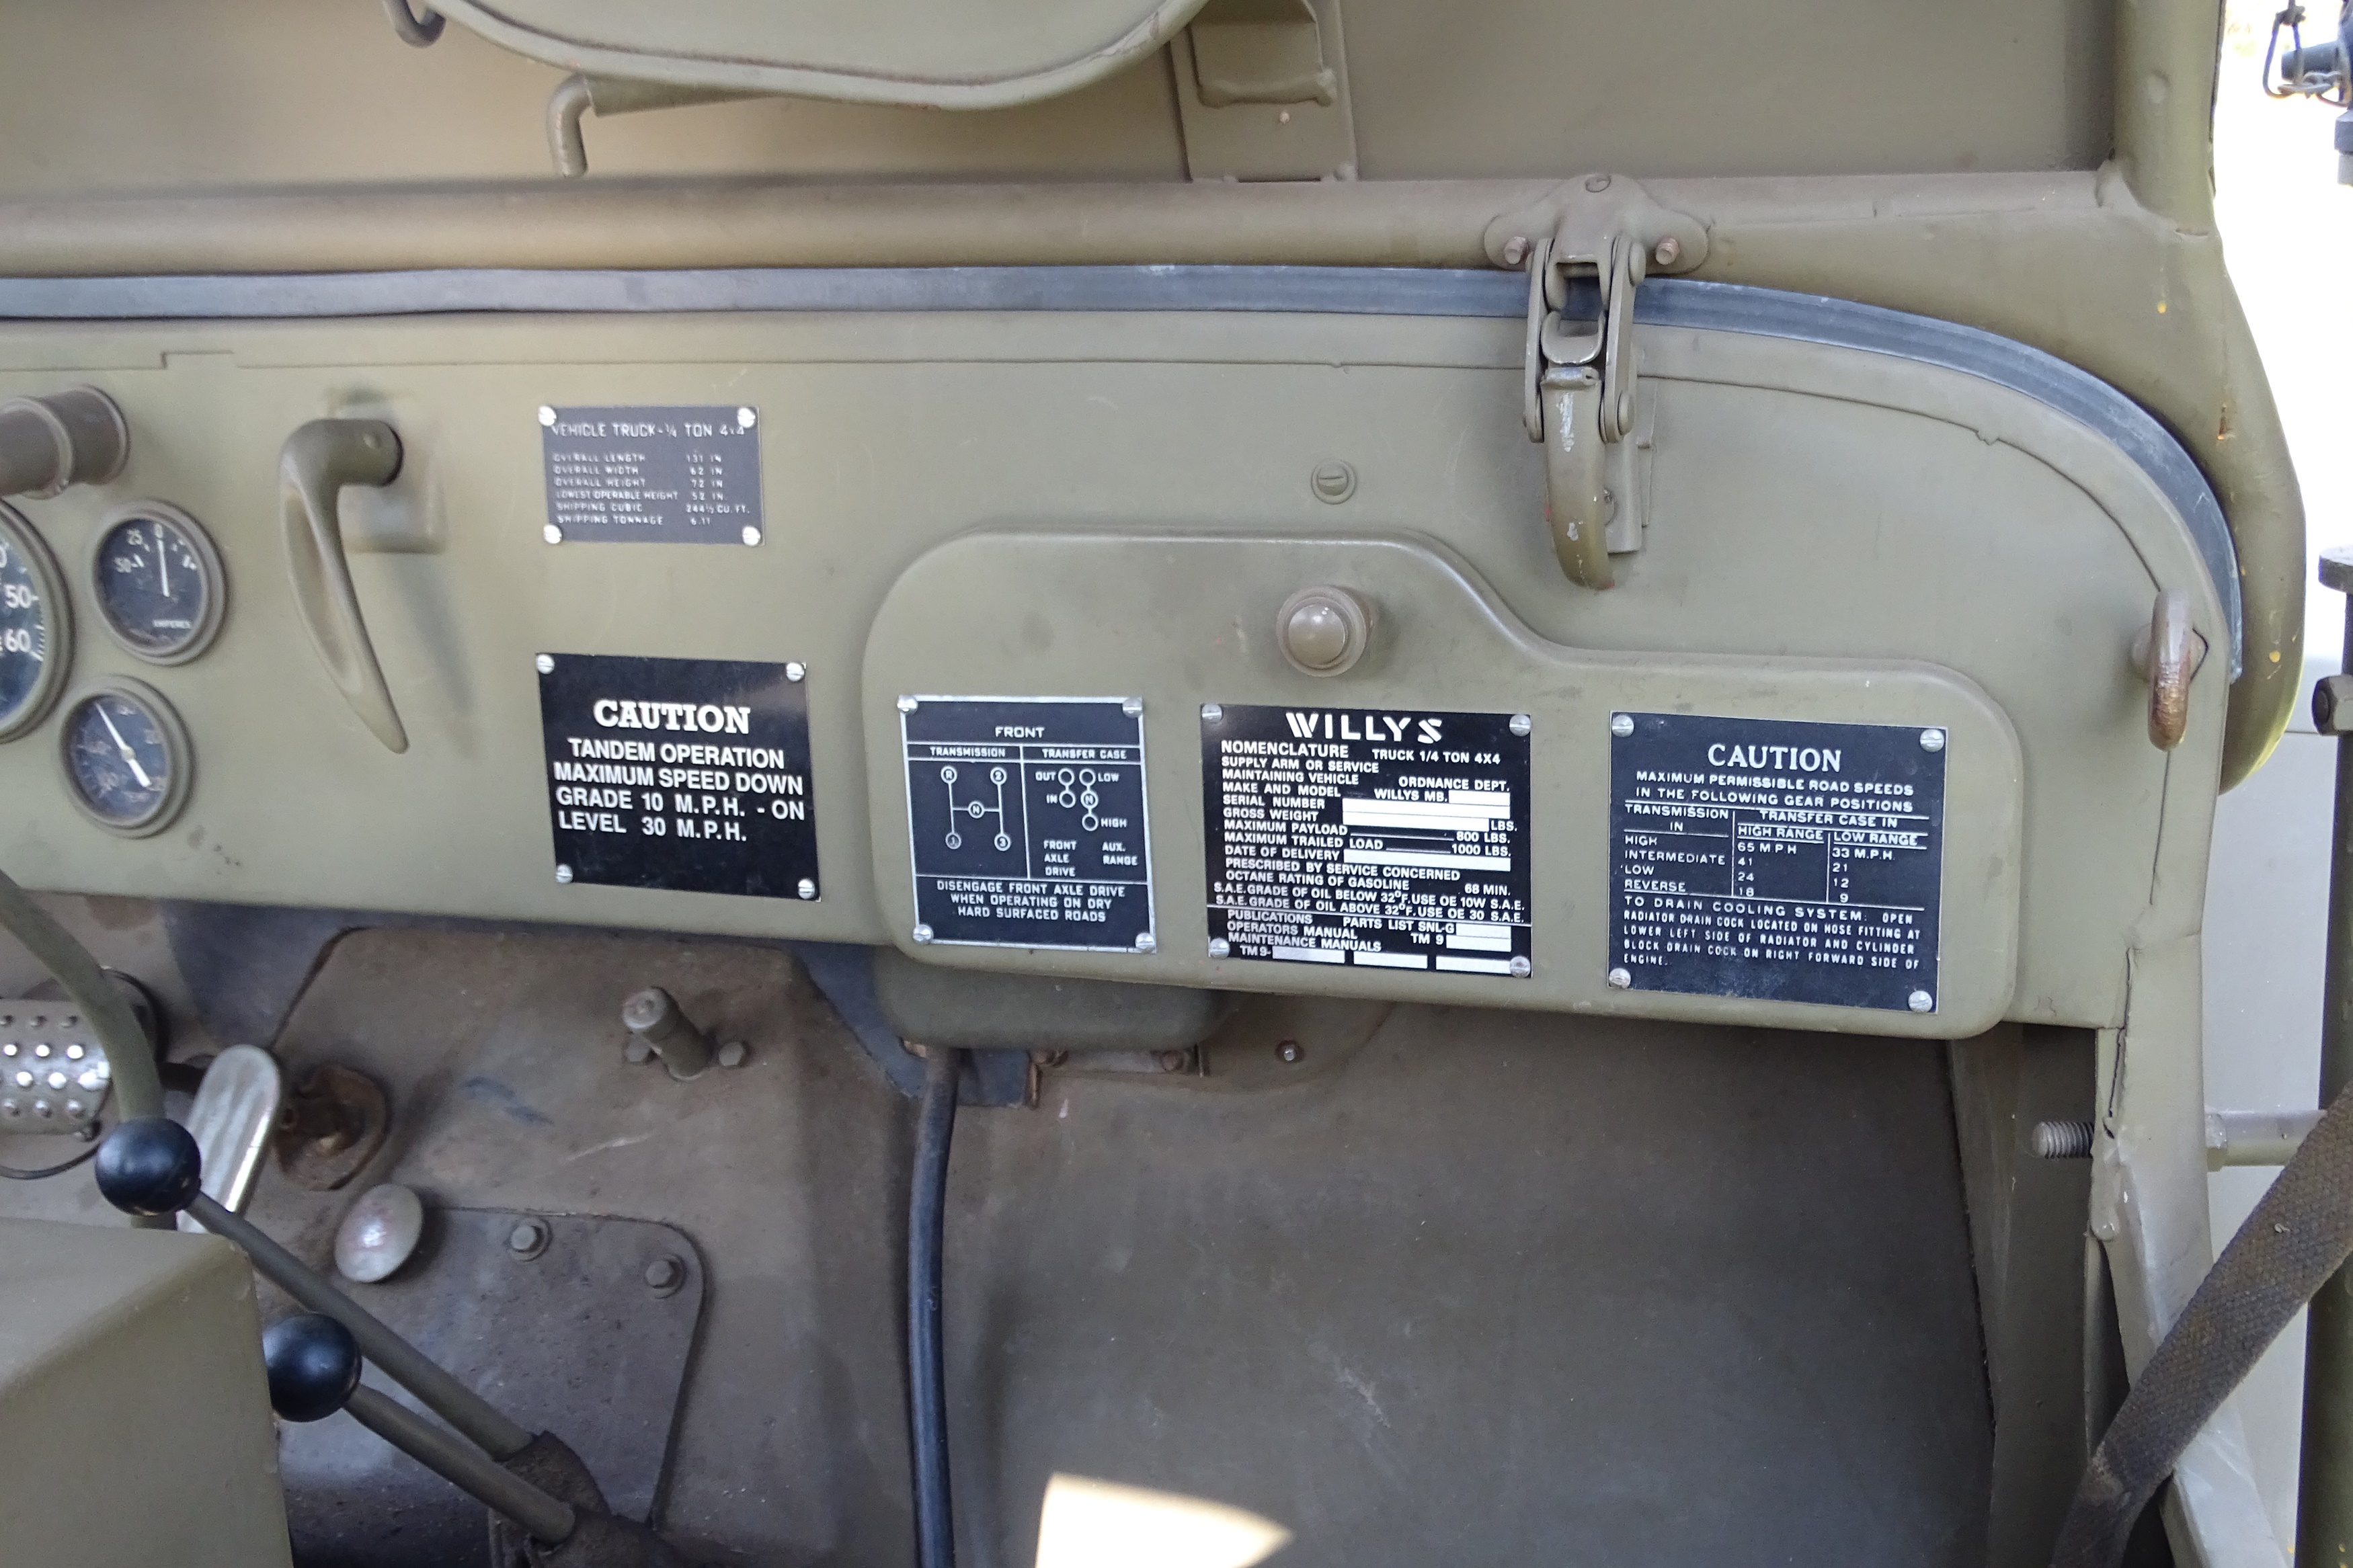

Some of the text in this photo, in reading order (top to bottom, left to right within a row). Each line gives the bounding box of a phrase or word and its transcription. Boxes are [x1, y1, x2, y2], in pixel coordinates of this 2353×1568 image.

[5, 585, 32, 608] 50
[5, 628, 31, 653] 60
[594, 698, 750, 735] CAUTION
[995, 727, 1045, 739] FRONT
[1285, 712, 1442, 743] WILLYS
[567, 738, 785, 769] TANDEM OPERATION
[930, 747, 1006, 757] TRANSMISSION
[1042, 749, 1127, 759] TRANSFER CASE
[1222, 741, 1501, 764] NOMENCLATURE TRUCK 1/4 TON 4X4
[1708, 743, 1841, 772] CAUTION
[1222, 756, 1379, 773] SUPPLY ARM OR SERVICE
[553, 761, 803, 796] MAXIMUM SPEED DOWN
[1035, 771, 1056, 781] OUT
[1098, 773, 1119, 782] LOW
[1222, 769, 1509, 792] MAINTAINING VEHICLE ORDNANCE DEPT.
[1636, 771, 1913, 796] MAXIMUM PERMISSIBLE ROAD SPEEDS
[1223, 782, 1419, 800] MAKE AND MODEL WILLYS
[555, 786, 805, 820] GRADE 10 M.P.H. ON
[1223, 794, 1325, 809] SERIAL NUMBER
[1657, 788, 1913, 813] THE FOLLOWING GEAR POSITIONS
[1224, 807, 1517, 831] GROSS WEIGHT LBS.
[1625, 804, 1728, 819] TRANSMISSION
[1759, 810, 1876, 827] TRANSFER CASE
[558, 811, 747, 842] LEVEL 30 M.P.H.
[1101, 818, 1127, 828] HIGH
[1224, 820, 1510, 843] MAXIMUM PAYLOAD 800 LBS.
[1625, 835, 1657, 845] HIGH
[1739, 826, 1823, 840] HIGH RANGE
[1834, 831, 1917, 846] LOW RANGE
[1043, 841, 1076, 850] FRONT
[1102, 842, 1125, 852] AUX.
[1225, 832, 1511, 857] MAXIMUM TRAILED LOAD 1000 LBS.
[1225, 845, 1339, 861] DATE DELIVERY
[1738, 842, 1755, 852] 65
[1832, 848, 1849, 858] 33
[1044, 854, 1069, 864] AXLE
[1103, 856, 1138, 866] RANGE
[1625, 850, 1725, 865] INTERMEDIATE
[1045, 867, 1076, 876] DRIVE
[1226, 858, 1460, 880] PRESCRIBED SERVICE CONCERNED
[1625, 864, 1654, 875] LOW
[1738, 872, 1754, 882] 24
[937, 882, 1125, 897] DISENGAGE FRONT AXLE DRIVE
[1226, 870, 1511, 896] OCTANE RATING GASOLINE 68 MIN.
[1625, 879, 1685, 892] REVERSE
[951, 895, 1112, 909] WHEN OPERATING DRY
[1312, 888, 1525, 911] OIL BELOW 10W S.A.E.
[958, 907, 1106, 922] HARD SURFACED ROADS
[1341, 903, 1484, 921] ABOVE 30
[1654, 898, 1913, 924] DRAIN COOLING OPEN
[1228, 909, 1455, 934] PUBLICATIONS PARTS LIST SNL-G
[1624, 910, 1901, 939] RADIATOR DRAIN COCK LOCATED HOSE FITTING
[1227, 921, 1358, 940] OPERATORS MANUAL
[1228, 932, 1382, 952] MAINTENANCE MANUALS
[1624, 925, 1914, 954] LOWER LEFT SIDE RADIATOR CYLINDER
[1624, 940, 1864, 965] BLOCK RIGHT FORWARD
